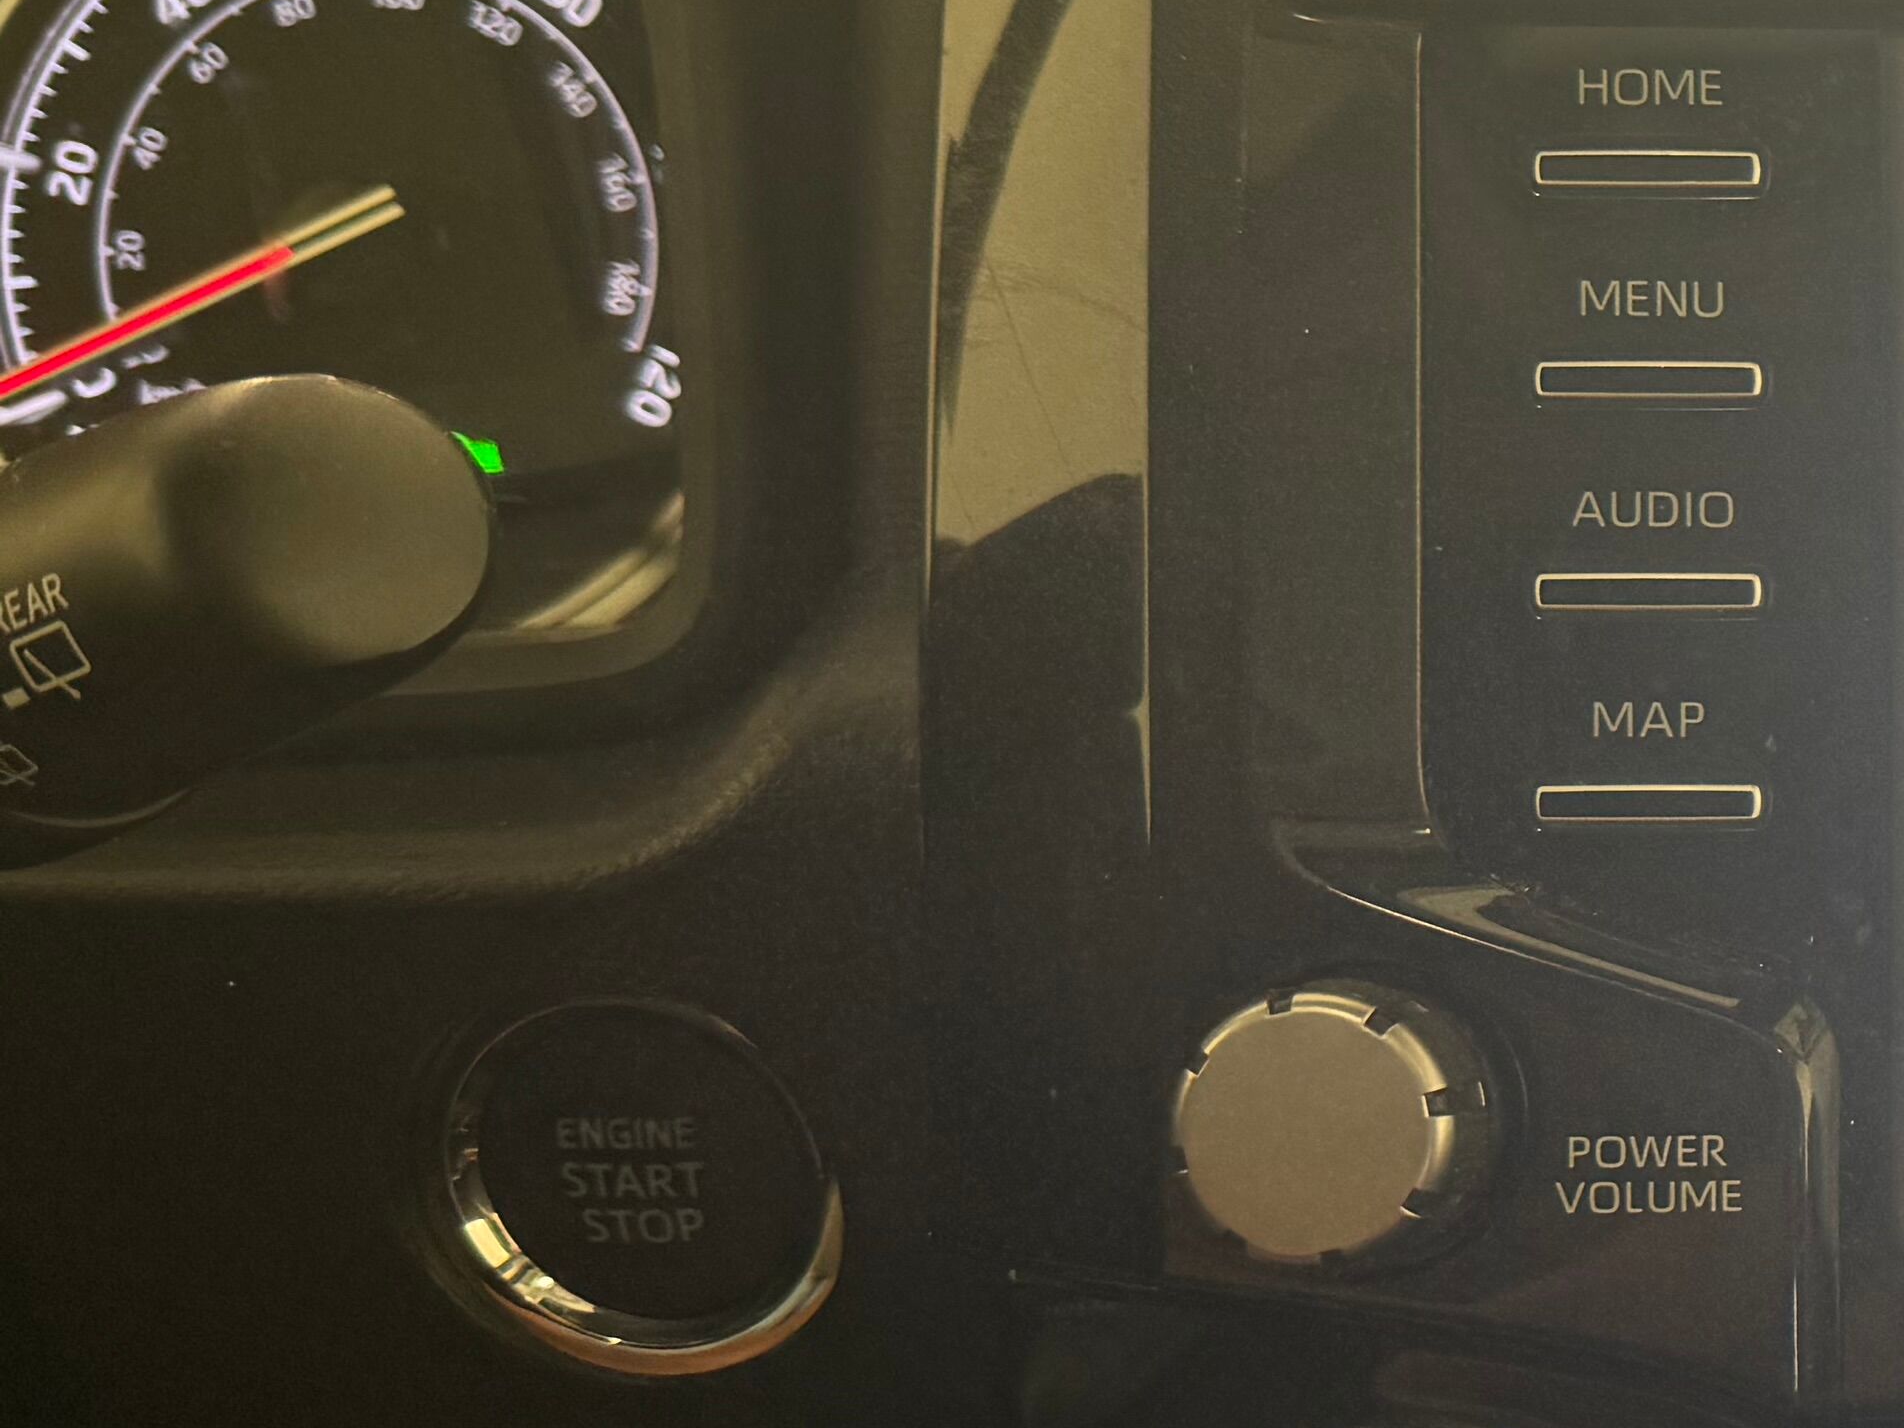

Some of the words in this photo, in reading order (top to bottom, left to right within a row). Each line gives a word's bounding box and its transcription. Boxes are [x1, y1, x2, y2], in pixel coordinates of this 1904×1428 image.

[187, 42, 229, 86] 60
[546, 63, 599, 119] 140
[1578, 67, 1723, 106] HOME
[131, 126, 169, 170] 40
[48, 141, 100, 206] 20
[113, 230, 147, 270] 20
[1580, 280, 1725, 318] MENU
[1572, 491, 1735, 529] AUDIO
[1593, 701, 1705, 738] MAP
[556, 1117, 695, 1150] ENGINE
[1567, 1134, 1727, 1169] POWER
[561, 1162, 704, 1199] START
[1556, 1178, 1743, 1214] VOLUME
[582, 1209, 704, 1243] STOP
